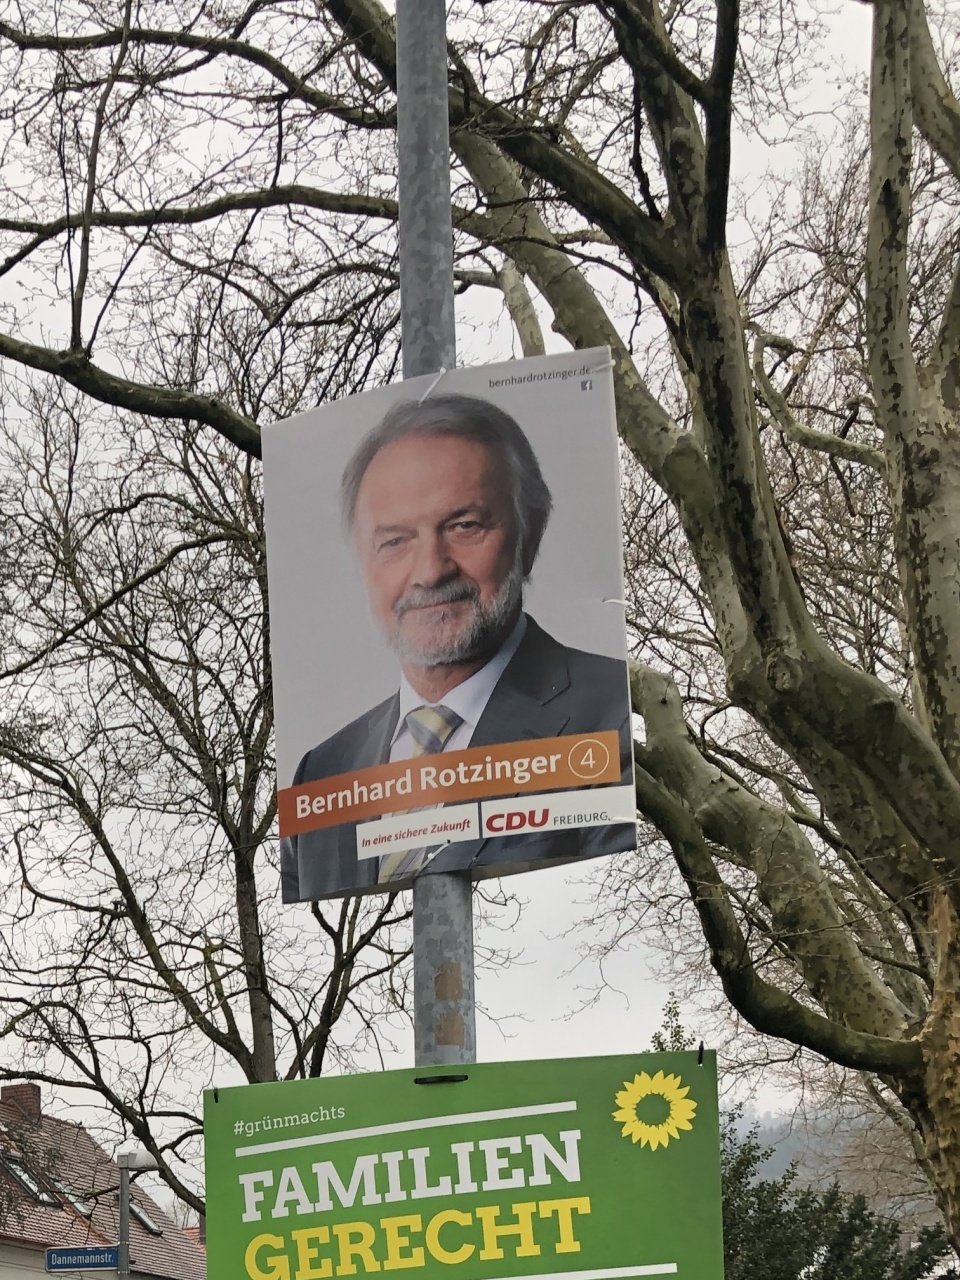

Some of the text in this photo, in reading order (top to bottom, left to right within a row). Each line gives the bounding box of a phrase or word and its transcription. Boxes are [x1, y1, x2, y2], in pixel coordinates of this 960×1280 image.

[489, 365, 590, 388] bernhardrotzinger.de
[296, 772, 413, 818] Bernhard
[420, 753, 562, 790] Rotzinger
[362, 819, 471, 848] In eine sichere Zukunft
[486, 808, 550, 832] CDU
[233, 1105, 346, 1138] #grünmachts
[239, 1129, 582, 1222] FAMILIEN
[51, 1253, 114, 1265] Dannemannstr.
